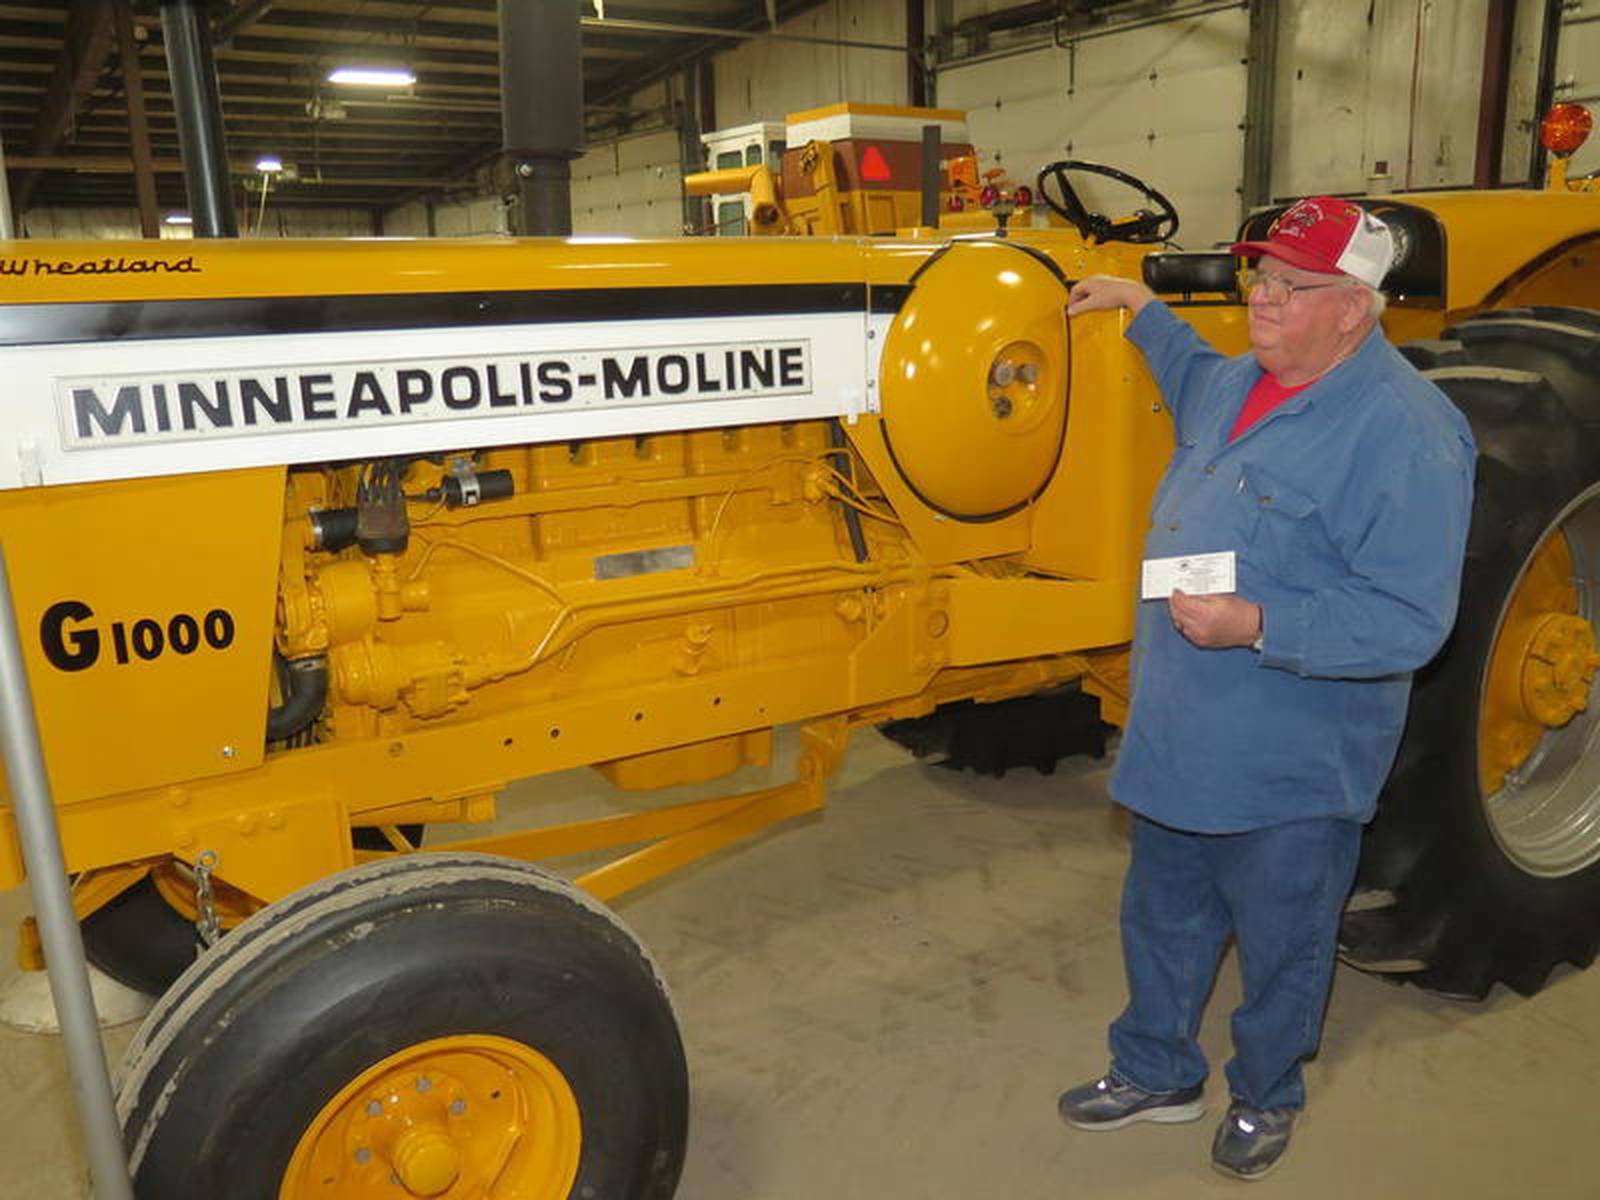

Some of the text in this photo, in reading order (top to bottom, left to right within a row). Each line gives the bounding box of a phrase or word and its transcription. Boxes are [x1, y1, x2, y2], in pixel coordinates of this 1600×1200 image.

[0, 256, 202, 276] Wheatland
[73, 346, 804, 439] MINNEAPOLIS-MOLINE
[39, 601, 235, 672] G1000
